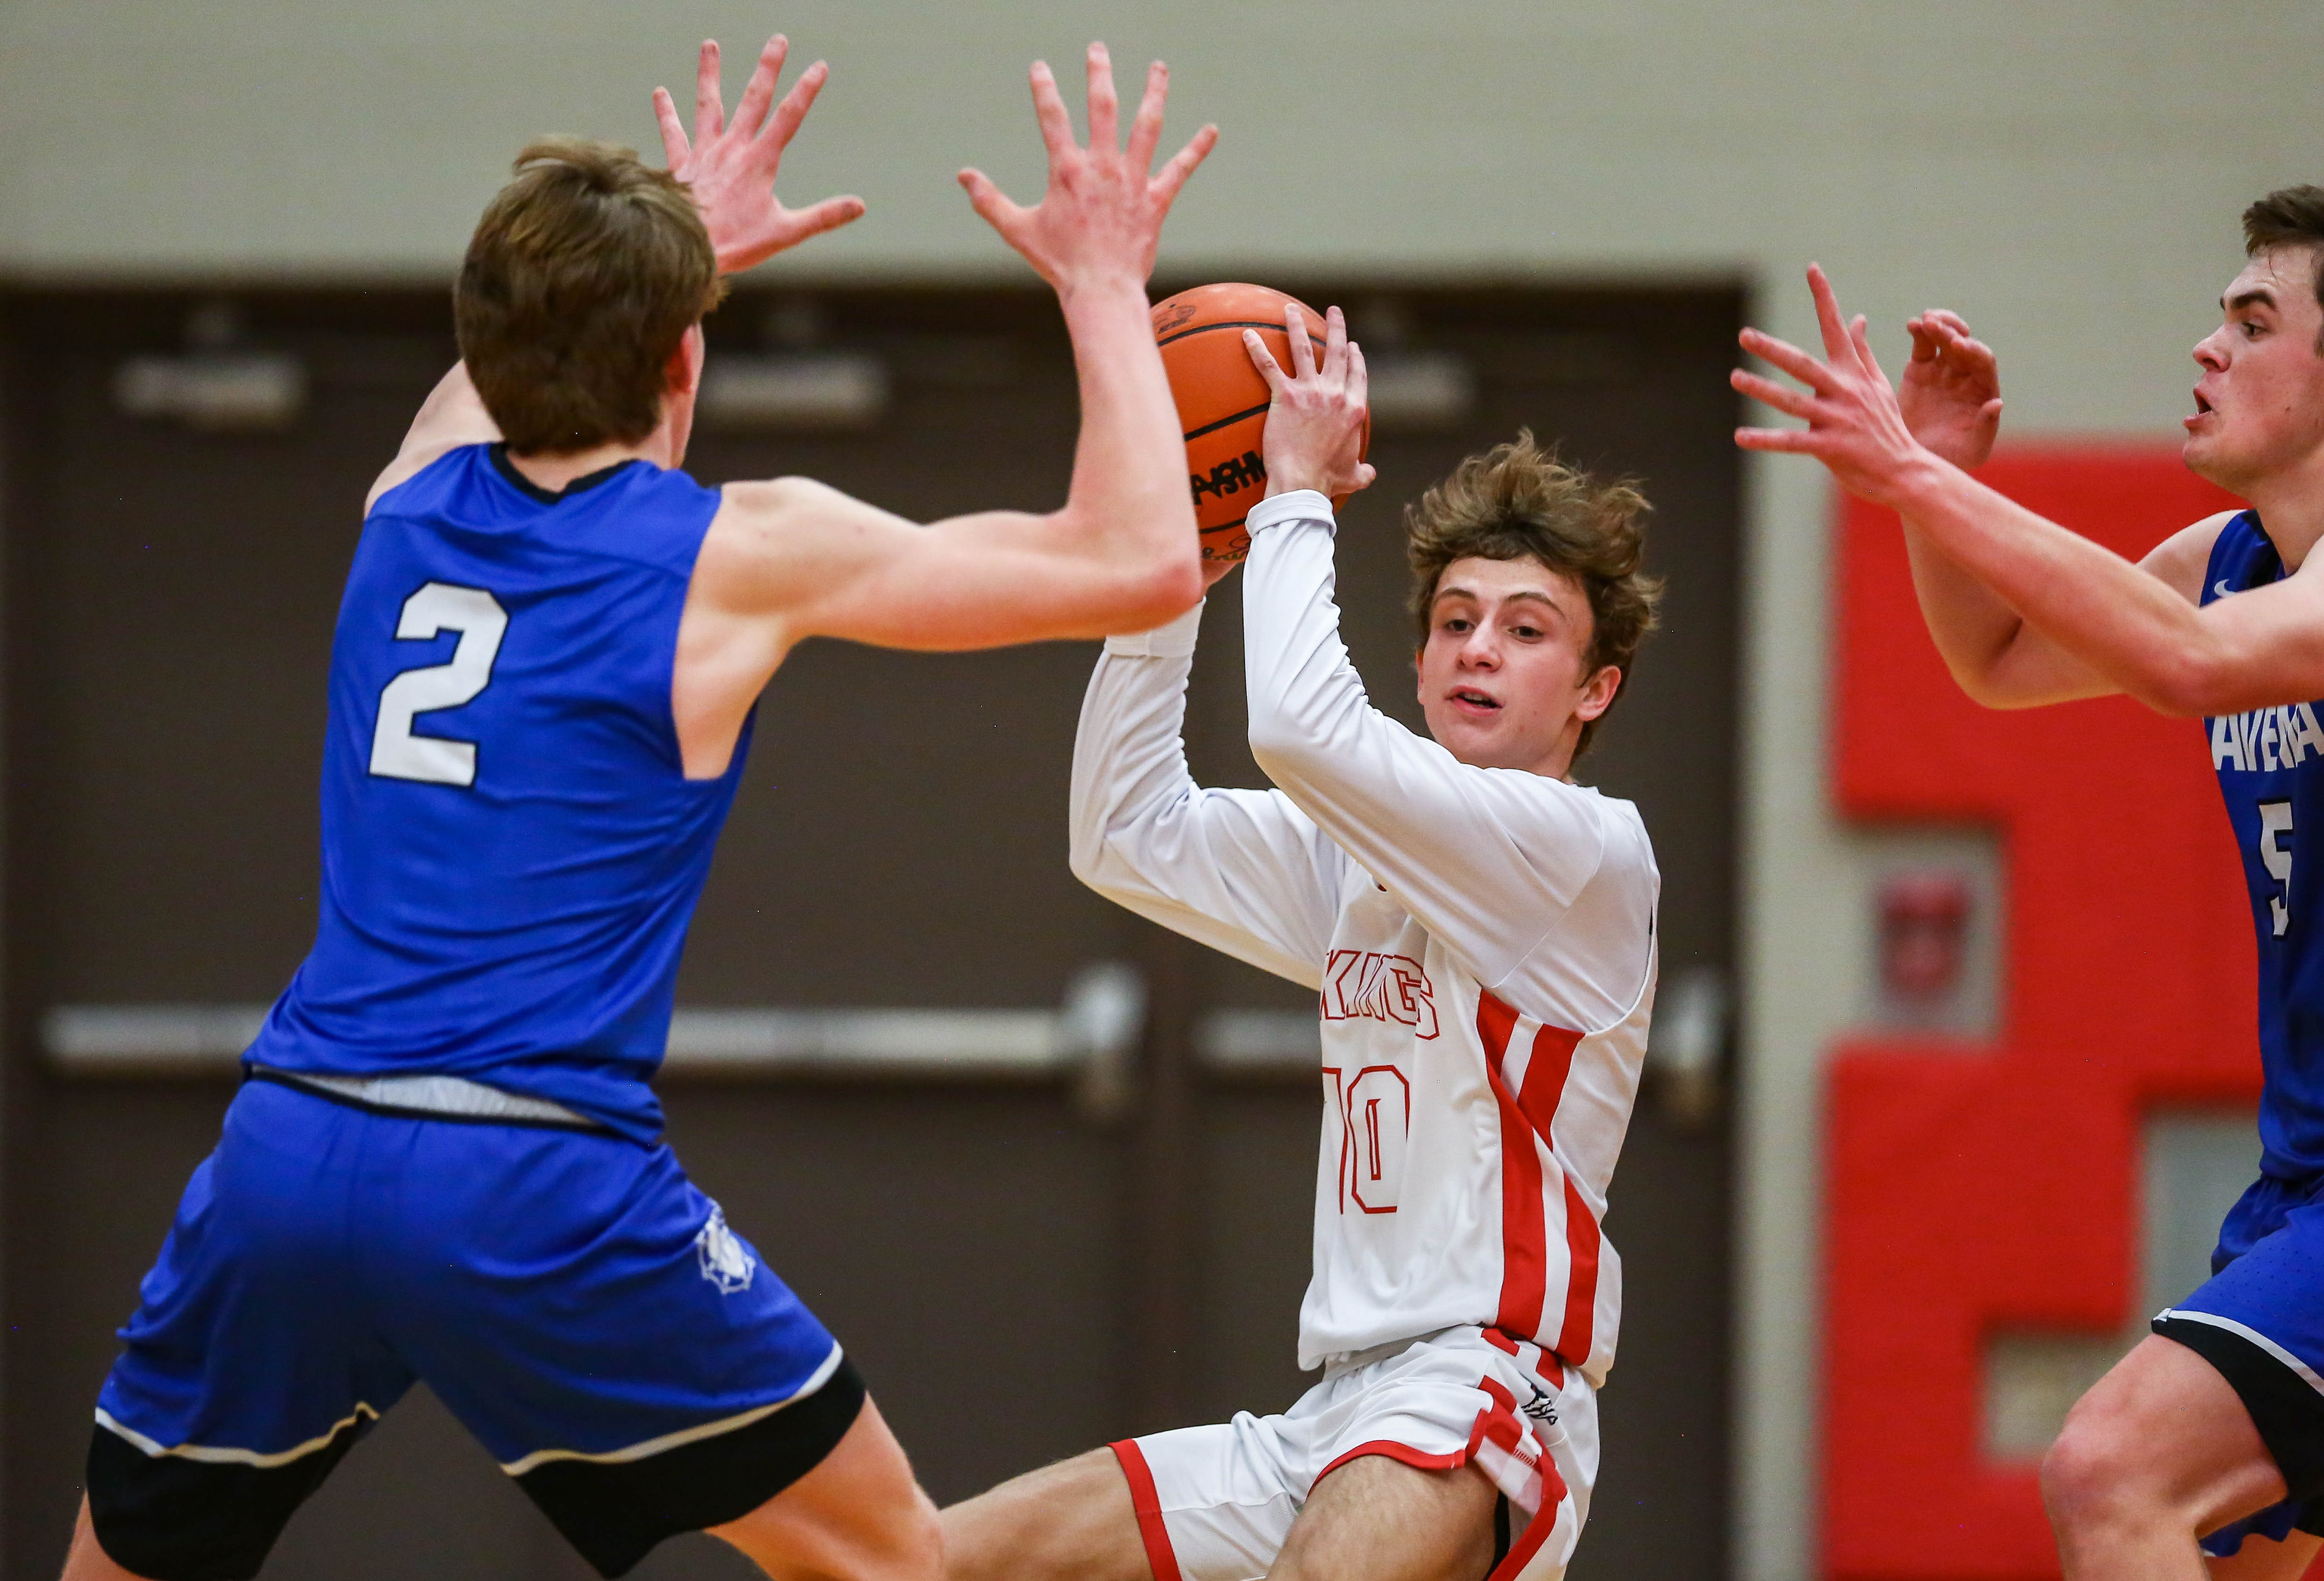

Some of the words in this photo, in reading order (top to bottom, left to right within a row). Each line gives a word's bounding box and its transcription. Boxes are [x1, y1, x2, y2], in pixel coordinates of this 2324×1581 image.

[369, 581, 509, 787] 2
[2258, 801, 2293, 937] 5
[1322, 1065, 1410, 1215] 10
